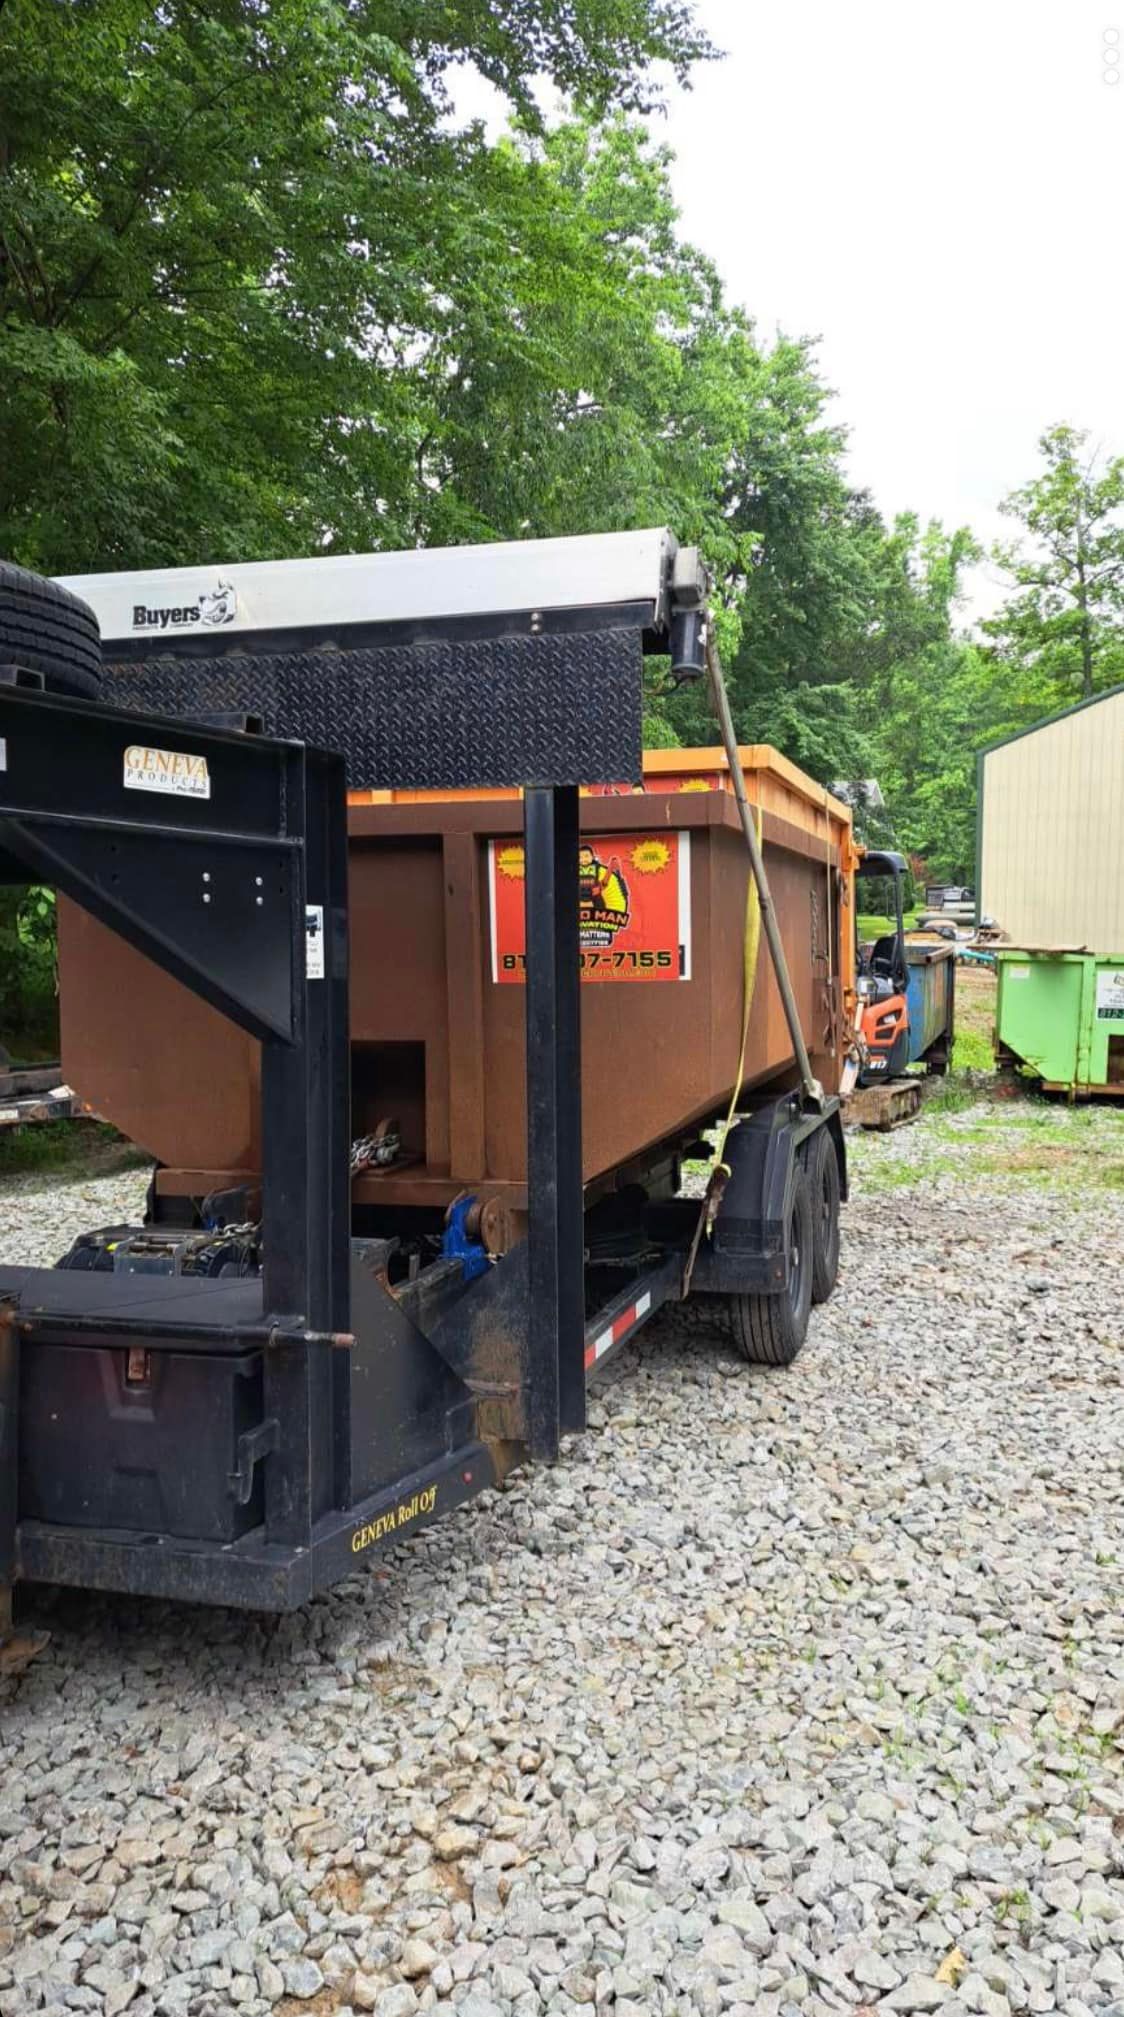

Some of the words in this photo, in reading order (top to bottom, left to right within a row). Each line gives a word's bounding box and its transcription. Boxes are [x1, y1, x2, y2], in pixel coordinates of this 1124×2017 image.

[133, 605, 201, 628] Buyers
[126, 748, 208, 777] GENEVA
[127, 768, 208, 788] PRODUCTS
[596, 910, 628, 925] MAN
[352, 1511, 395, 1552] GENEVA
[398, 1498, 418, 1525] Roll
[419, 1484, 438, 1512] Off
